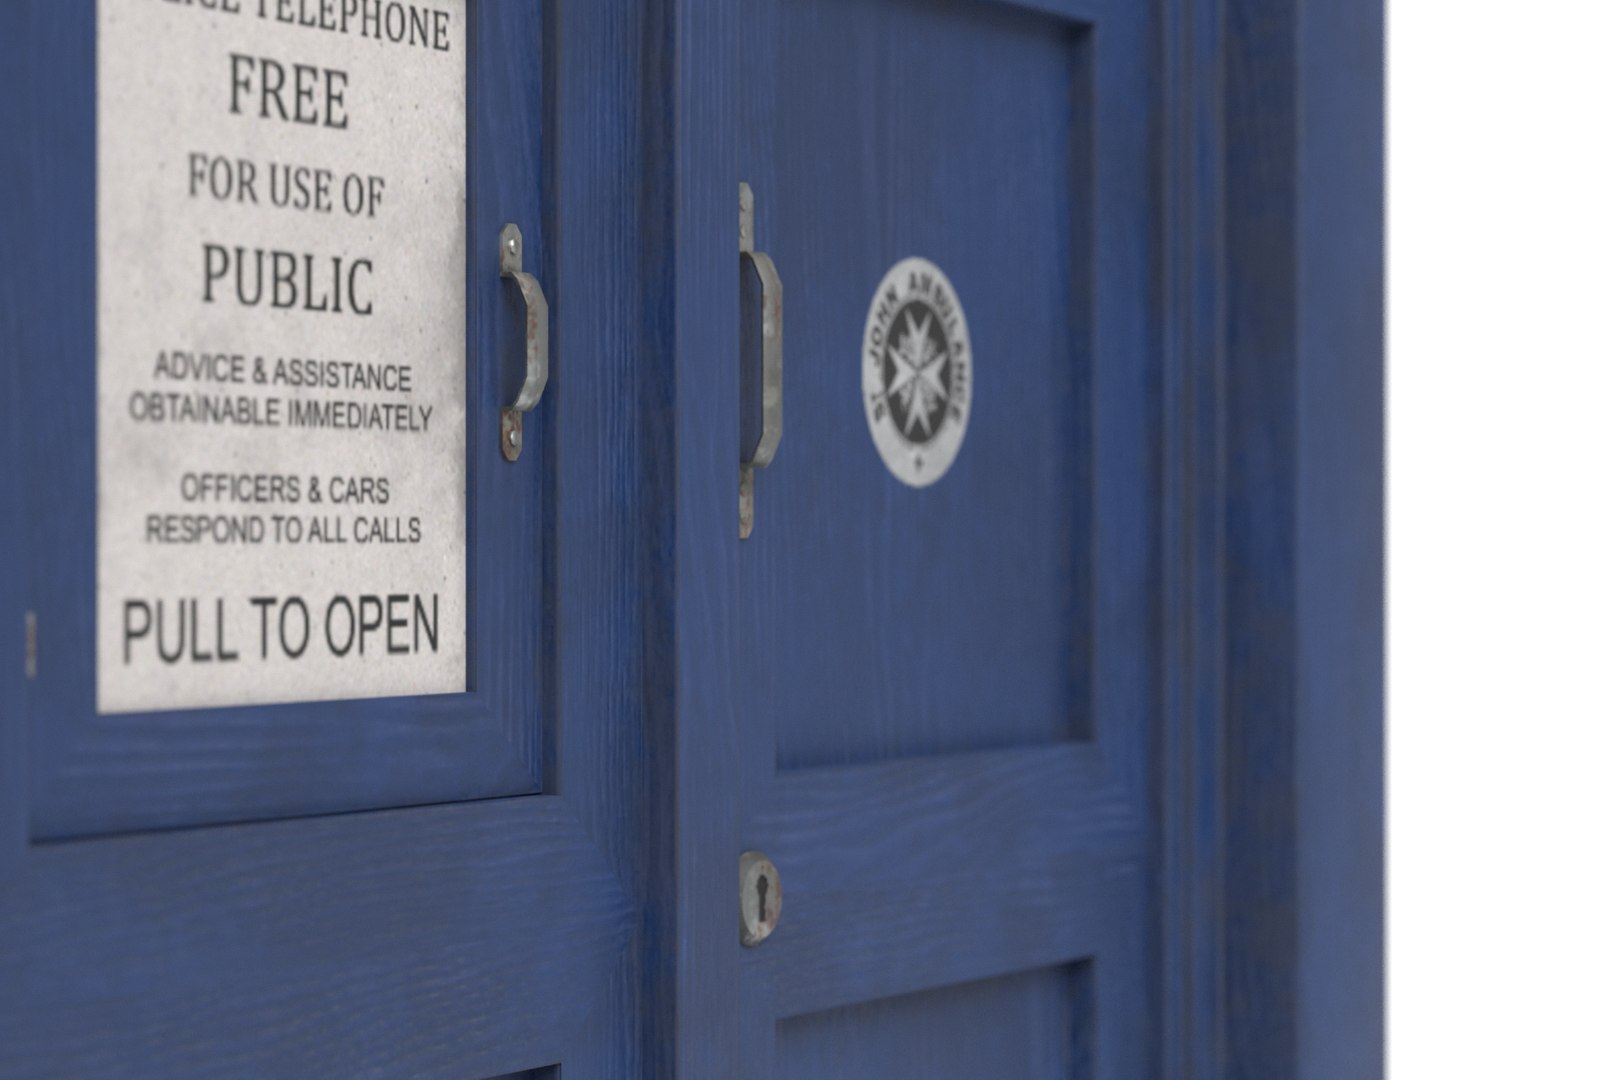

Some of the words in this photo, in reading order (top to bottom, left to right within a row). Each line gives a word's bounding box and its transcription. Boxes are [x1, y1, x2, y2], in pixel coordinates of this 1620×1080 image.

[230, 54, 348, 129] FREE
[190, 154, 257, 202] FOR
[271, 164, 331, 212] USE
[343, 174, 384, 217] OF
[203, 244, 372, 315] PUBLIC
[156, 352, 243, 382] ADVICE
[253, 357, 266, 383] &
[274, 359, 411, 392] ASSISTANCE
[130, 392, 279, 425] OBTAINABLE
[289, 400, 432, 431] IMMEDIATELY
[182, 474, 300, 503] OFFICERS
[309, 477, 322, 503] &
[330, 477, 389, 504] CARS
[147, 515, 264, 542] RESPOND
[272, 515, 302, 542] TO
[309, 518, 346, 542] ALL
[354, 517, 421, 543] CALLS
[124, 599, 238, 664] PULL
[250, 596, 310, 659] TO
[325, 594, 438, 657] OPEN
